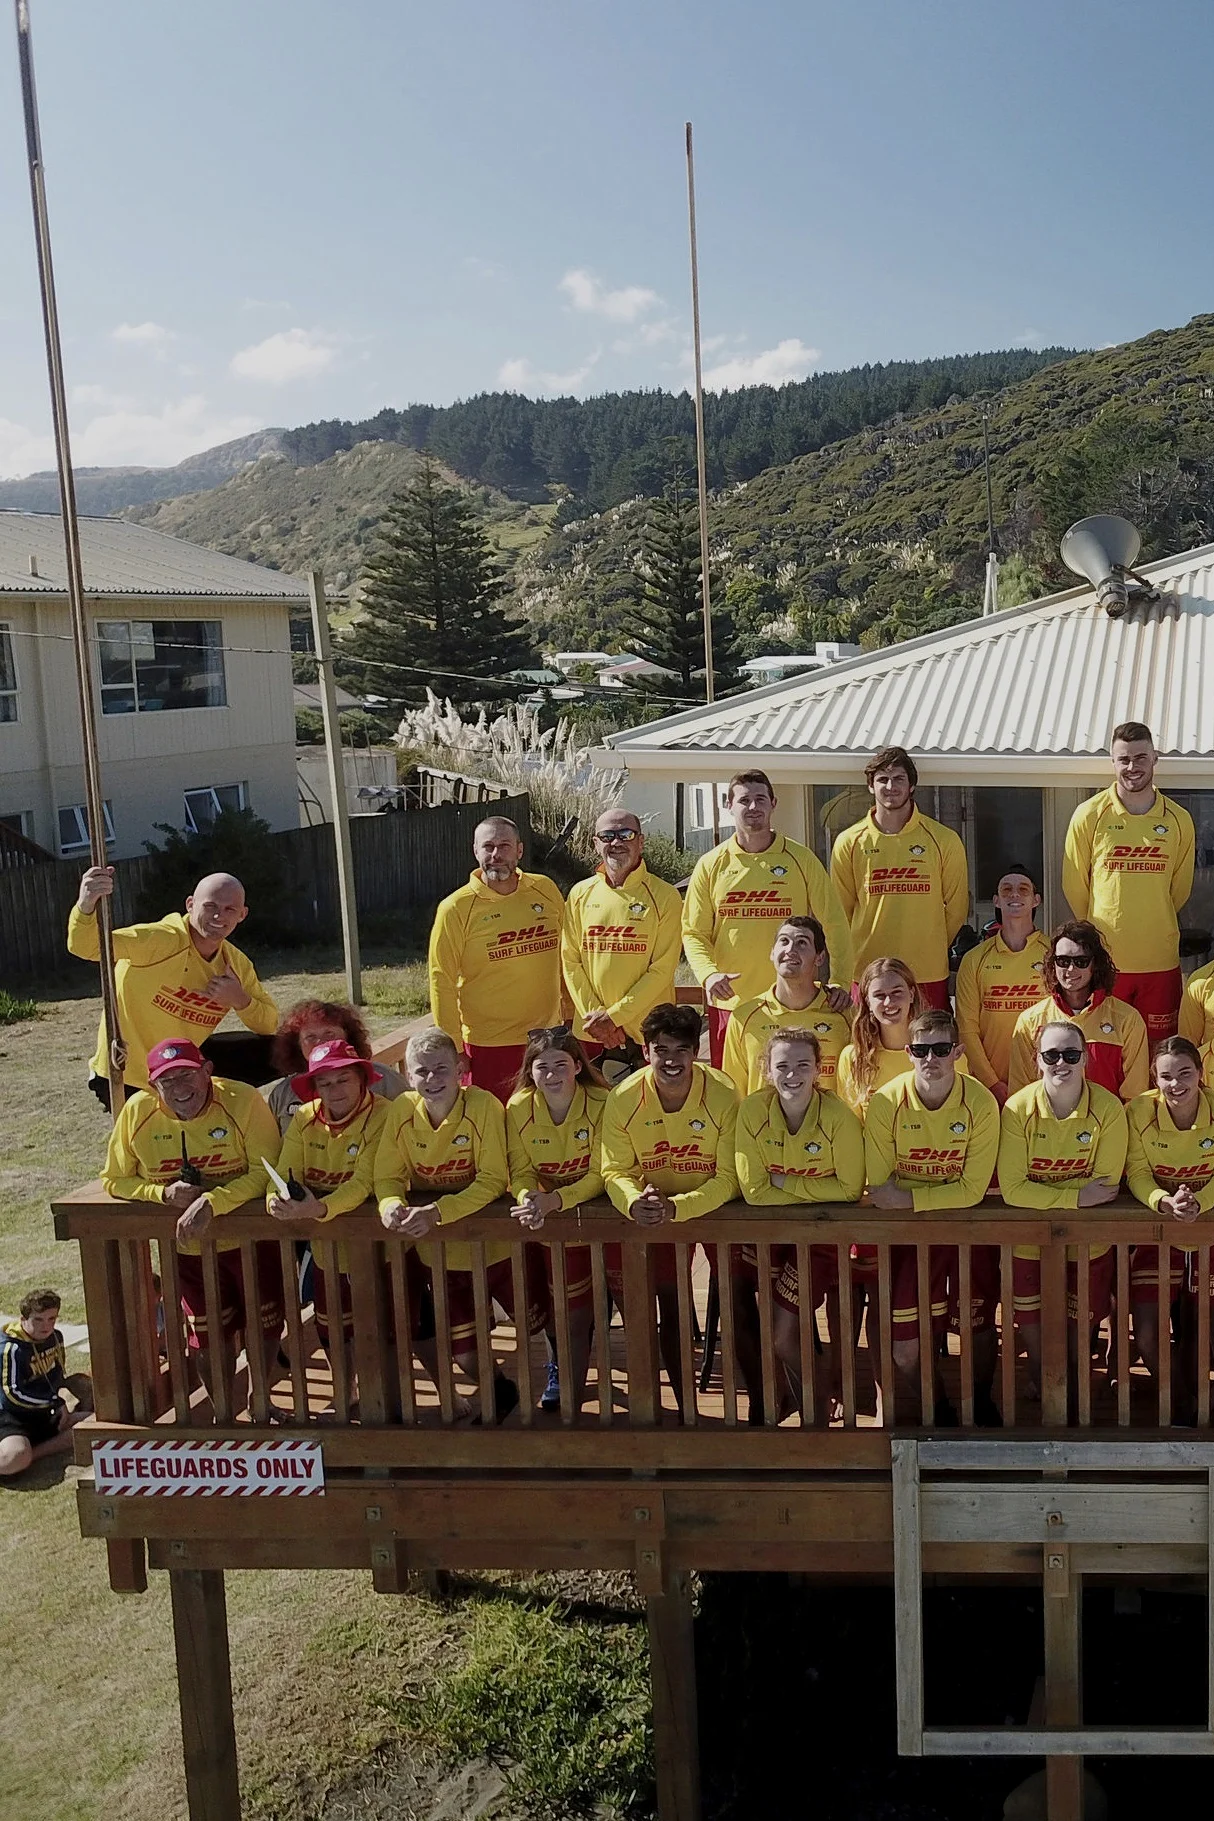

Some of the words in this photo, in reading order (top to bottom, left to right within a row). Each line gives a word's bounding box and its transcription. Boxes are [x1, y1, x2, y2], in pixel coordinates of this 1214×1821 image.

[1113, 845, 1163, 858] DHL
[1103, 861, 1125, 870] SURF
[1127, 862, 1166, 872] LIFEGUAR
[872, 867, 920, 880] DHL
[884, 883, 931, 893] LIFEGUARD
[726, 890, 782, 904] DHL
[742, 907, 792, 917] LIFEGUARD
[498, 924, 549, 945] DHL
[588, 925, 638, 938] DHL
[488, 947, 514, 960] SURF
[516, 938, 559, 954] LIFEGUARD
[582, 941, 597, 951] SRF
[600, 942, 647, 952] LIFEGUARD
[990, 984, 1041, 996] DHL
[152, 994, 181, 1014] SURF
[653, 1118, 663, 1127] TSB
[654, 1140, 703, 1158] DHL
[908, 1147, 965, 1162] DHL
[416, 1158, 473, 1175] DHL
[642, 1157, 668, 1170] SURF
[900, 1163, 923, 1174] SURF
[1031, 1157, 1089, 1171] DHL
[1154, 1163, 1214, 1177] DHL
[99, 1458, 249, 1479] LIFEGUARDS
[256, 1458, 315, 1479] ONLY
